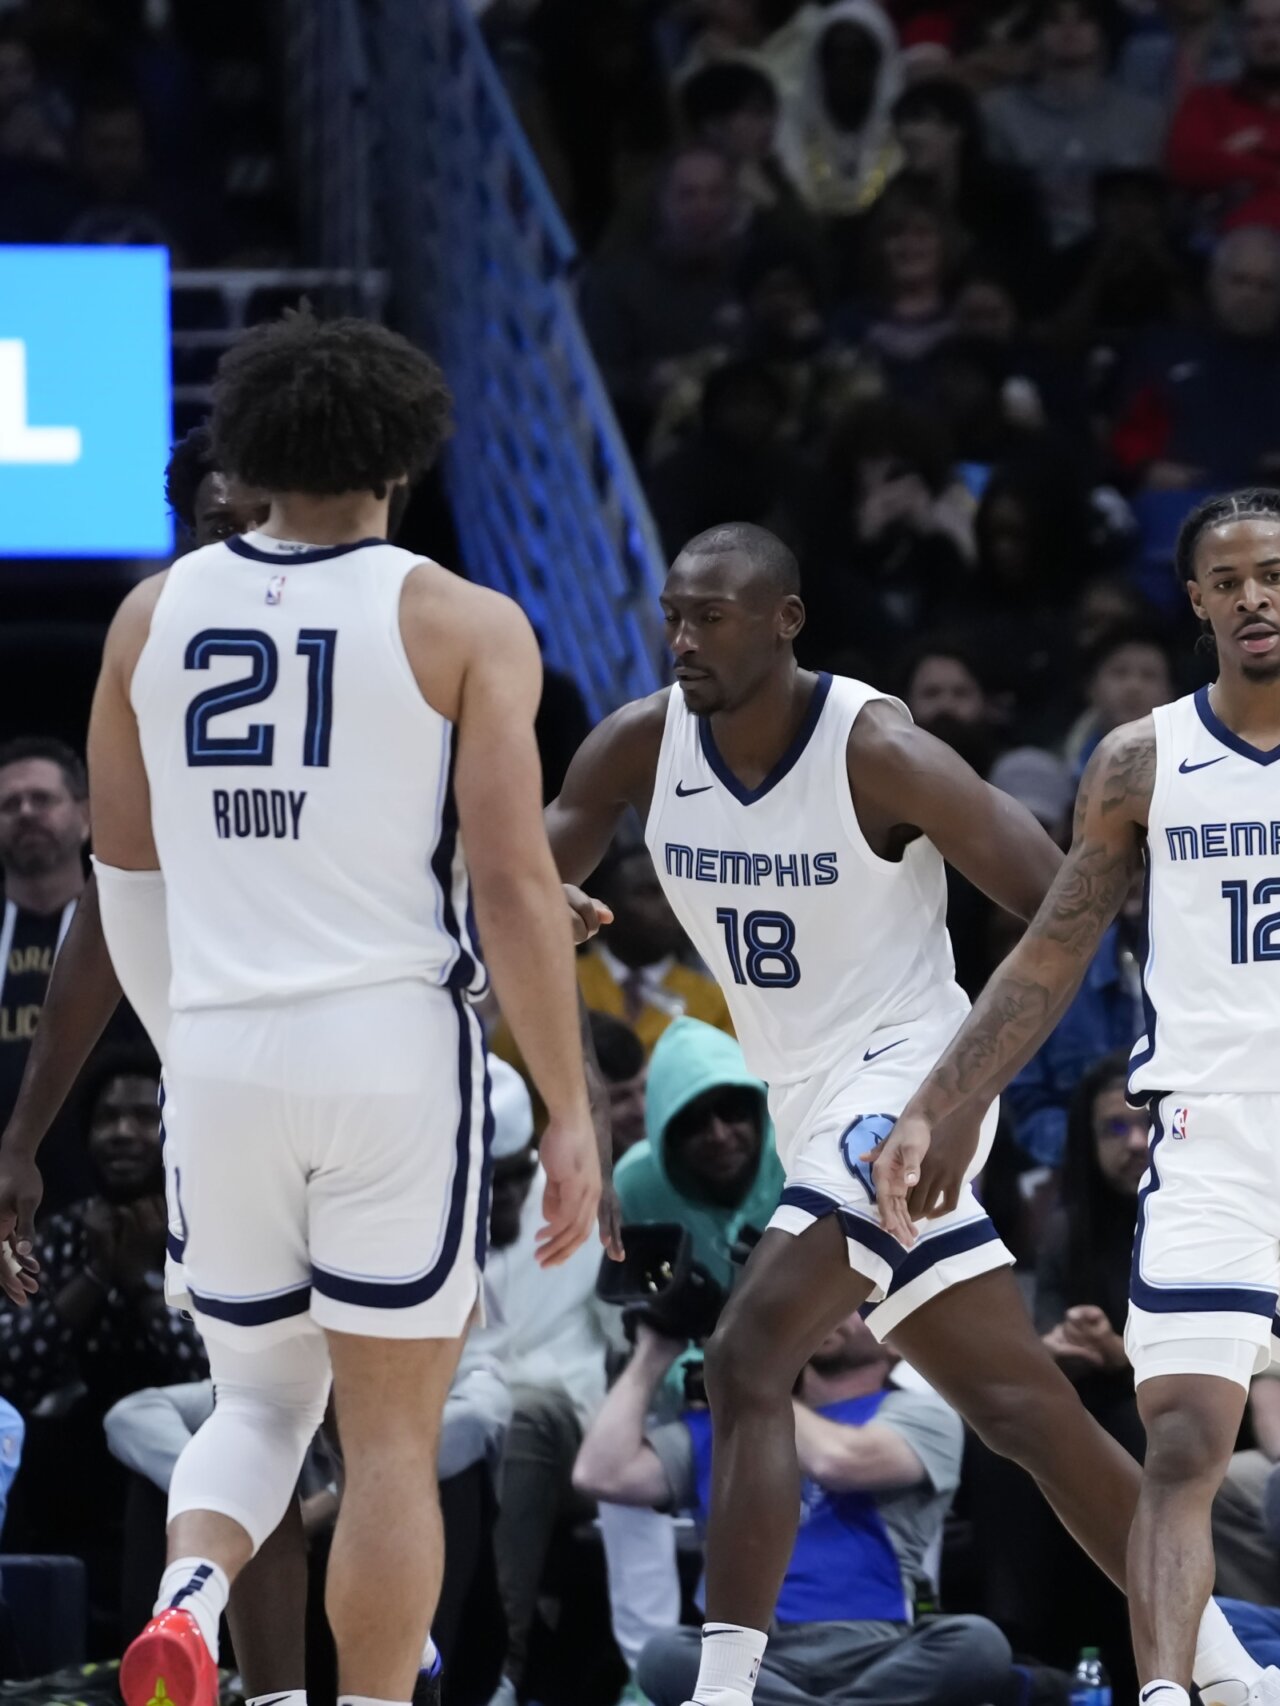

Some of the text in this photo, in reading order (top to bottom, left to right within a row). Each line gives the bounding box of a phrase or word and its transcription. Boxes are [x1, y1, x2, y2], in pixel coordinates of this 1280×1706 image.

[184, 628, 338, 768] 21
[213, 788, 307, 840] RODDY
[665, 842, 840, 888] MEMPHIS
[716, 907, 802, 989] 18
